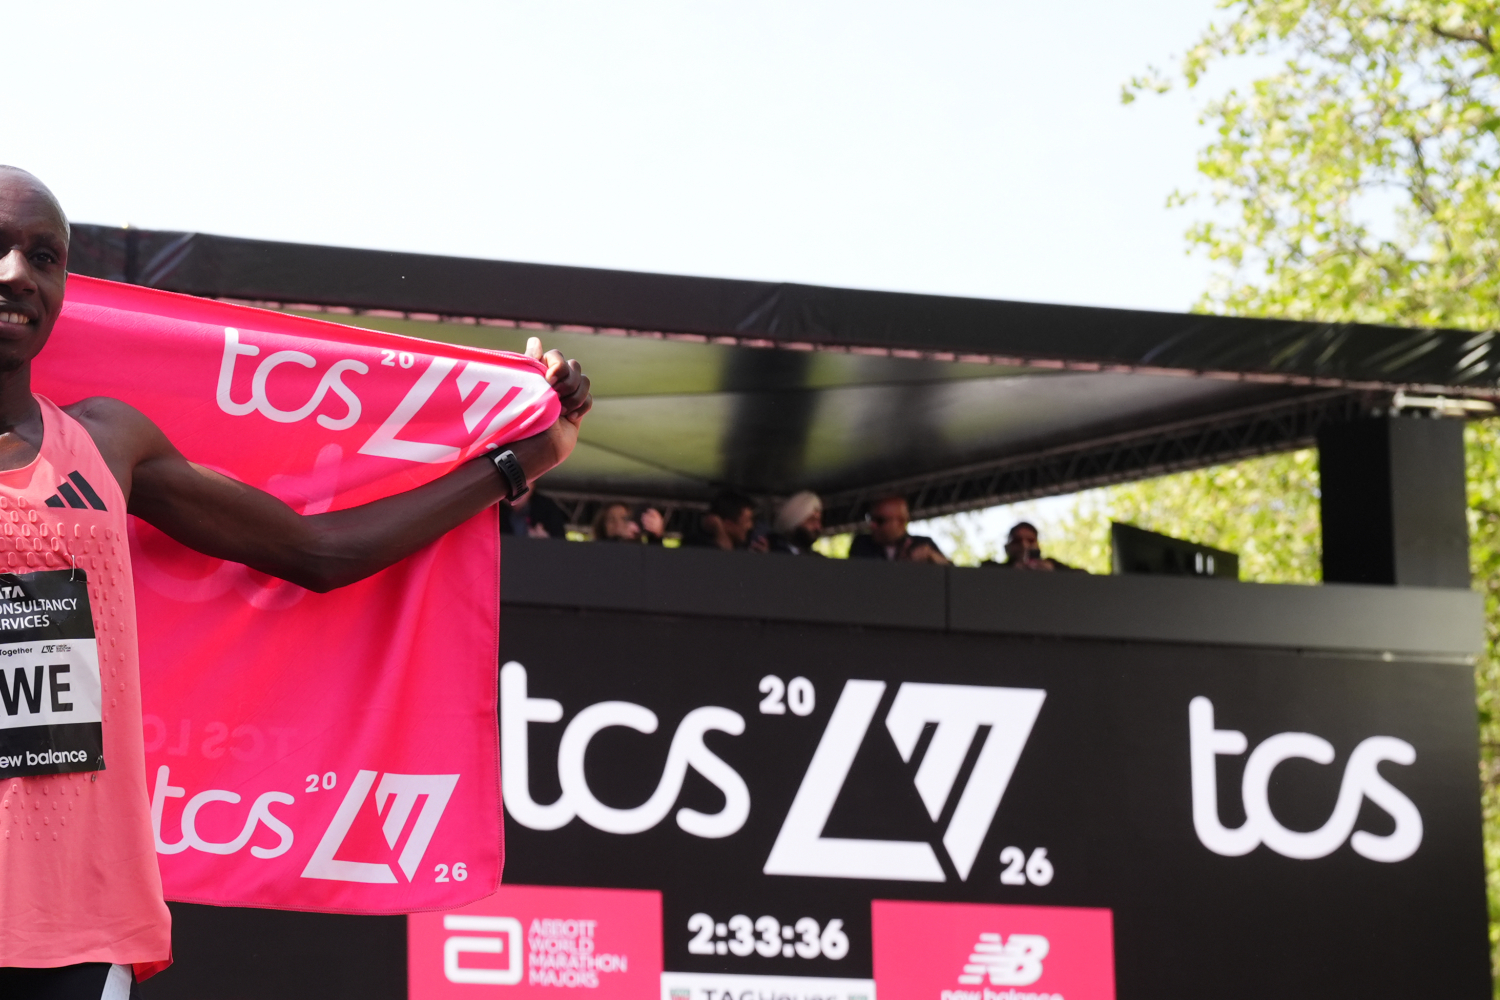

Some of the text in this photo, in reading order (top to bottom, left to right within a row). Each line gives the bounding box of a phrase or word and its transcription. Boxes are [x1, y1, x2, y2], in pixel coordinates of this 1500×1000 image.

[216, 327, 369, 431] tcs
[380, 349, 414, 369] 20
[25, 748, 88, 767] balance
[500, 660, 751, 839] tcs
[759, 674, 816, 716] 20
[1000, 846, 1054, 886] 26
[1189, 695, 1423, 863] tcs
[151, 764, 295, 859] tcs
[305, 771, 337, 793] 20
[434, 862, 468, 884] 26
[529, 918, 597, 938] ABBOTT
[529, 936, 595, 955] WORLD
[687, 913, 850, 961] 2:33:36
[529, 952, 628, 974] MARATHON
[529, 969, 599, 989] MAJORS
